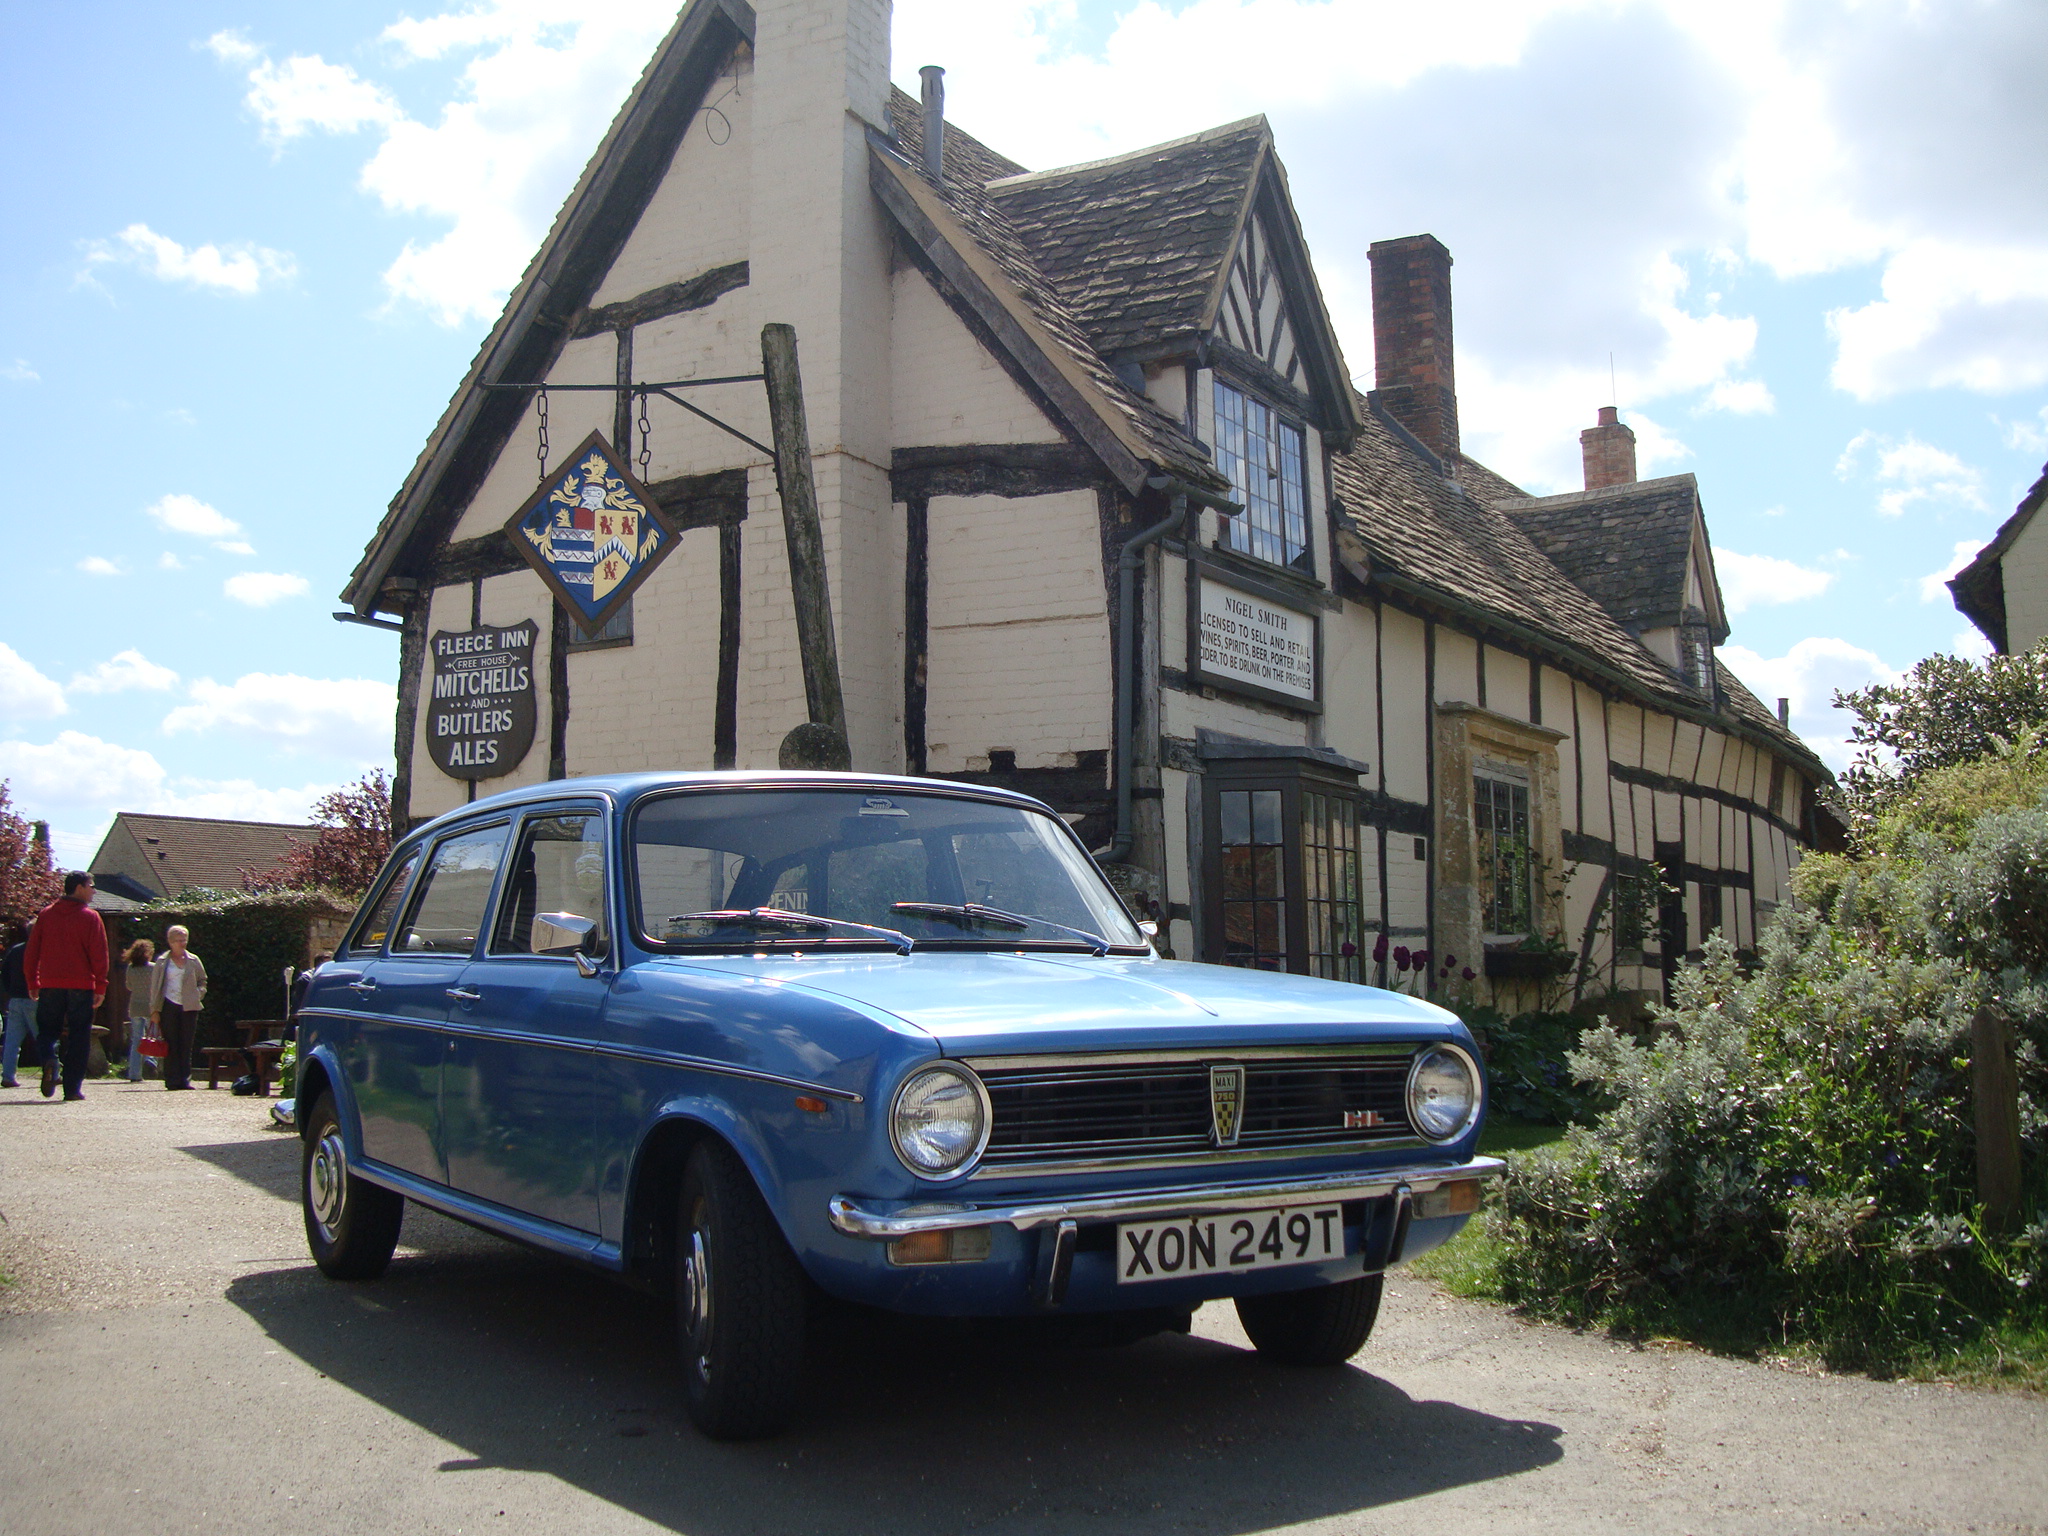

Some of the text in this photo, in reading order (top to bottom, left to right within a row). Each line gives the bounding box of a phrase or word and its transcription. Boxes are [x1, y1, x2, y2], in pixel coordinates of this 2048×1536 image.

[1225, 597, 1287, 630] NIGEL SMITH
[438, 630, 530, 656] FLEECE INN
[1238, 624, 1249, 638] TO
[1251, 628, 1268, 645] SELL
[1270, 635, 1285, 650] AND
[1288, 640, 1310, 659] RETAIL
[458, 655, 508, 669] FREE HOUSE
[1224, 636, 1251, 658] SPIRITS,
[1252, 645, 1270, 665] BEER,
[1270, 652, 1294, 670] PORTER
[1297, 660, 1310, 674] AND
[436, 666, 528, 698] MITCHELLS
[1220, 652, 1228, 666] TO
[1230, 655, 1238, 669] BE
[1239, 658, 1260, 676] DRUNK
[1262, 665, 1272, 680] ON
[1272, 668, 1284, 682] THE
[1286, 672, 1311, 690] PREMISES
[470, 698, 490, 710] AND
[438, 710, 513, 736] BUTLERS
[450, 740, 499, 766] ALES
[1216, 1076, 1234, 1088] MAXI
[1344, 1110, 1384, 1128] HL
[1126, 1209, 1338, 1277] XON 249T
